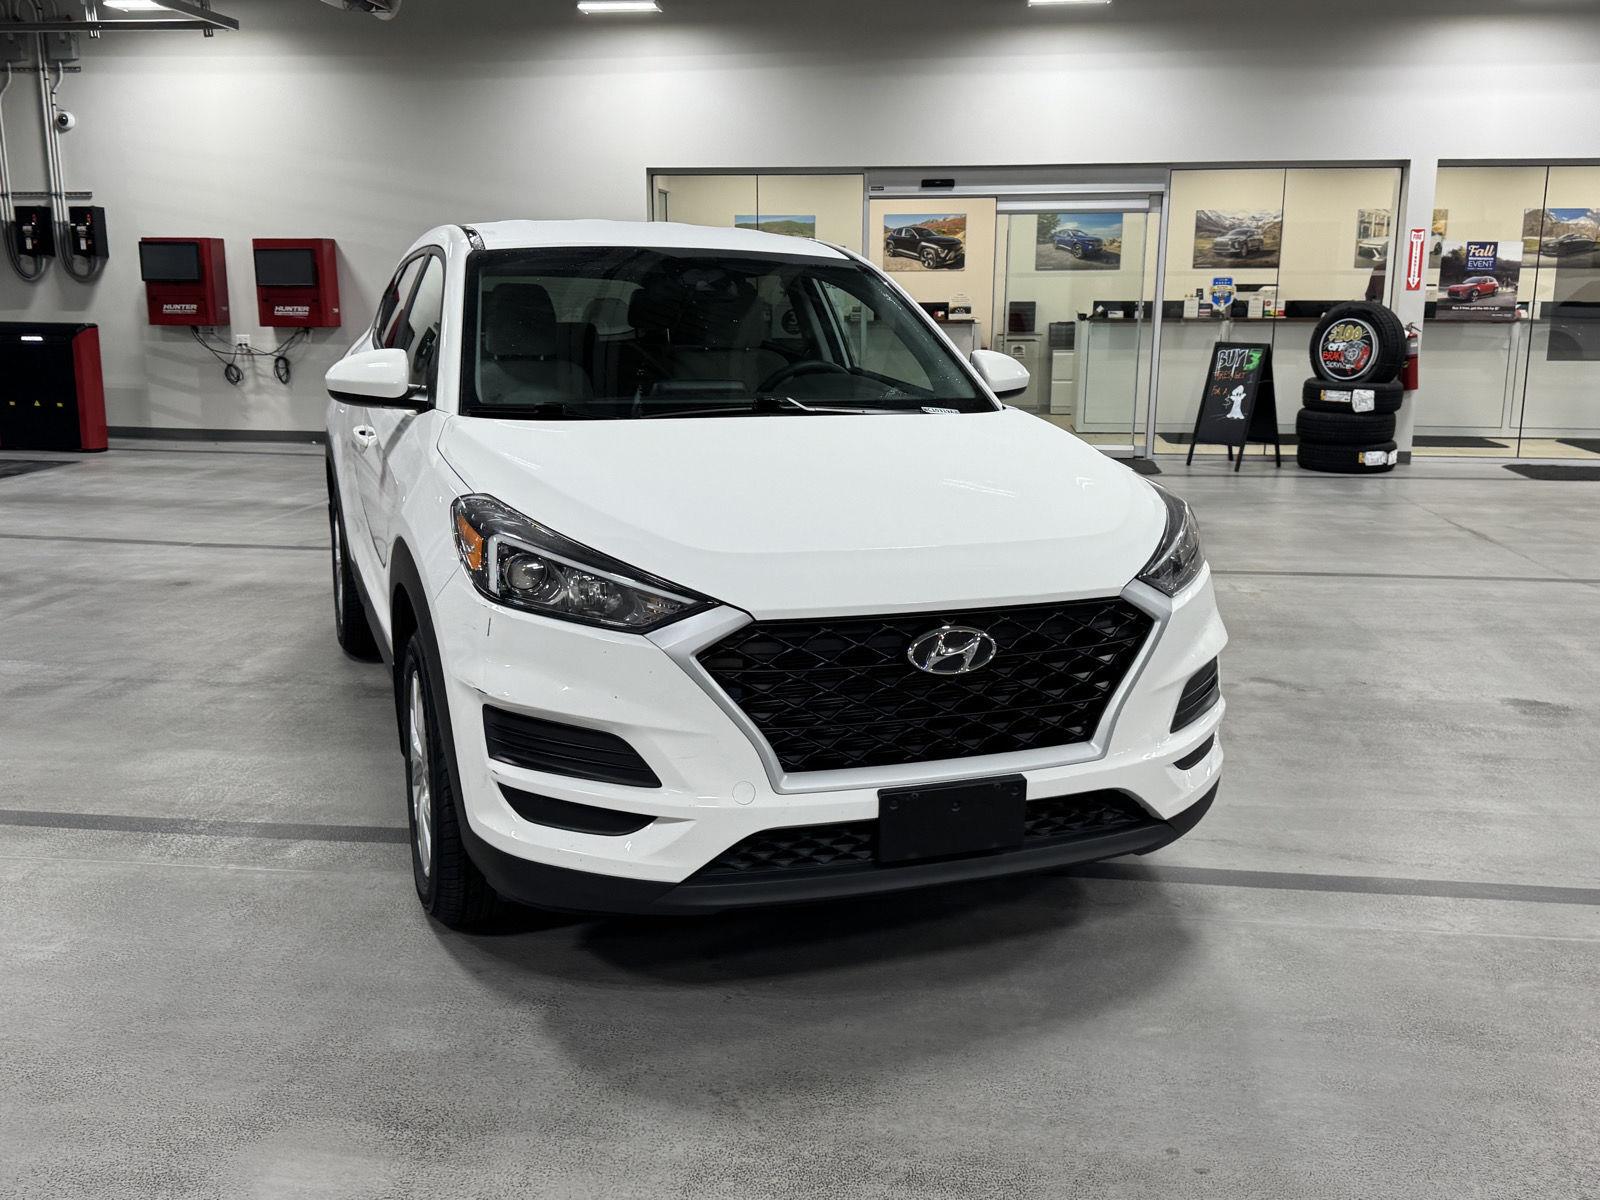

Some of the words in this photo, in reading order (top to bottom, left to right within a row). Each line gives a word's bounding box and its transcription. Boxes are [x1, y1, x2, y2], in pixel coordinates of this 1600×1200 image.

[1469, 245, 1495, 256] Fall
[1329, 325, 1362, 342] $100
[1217, 349, 1248, 368] BUY
[1242, 348, 1264, 370] 3
